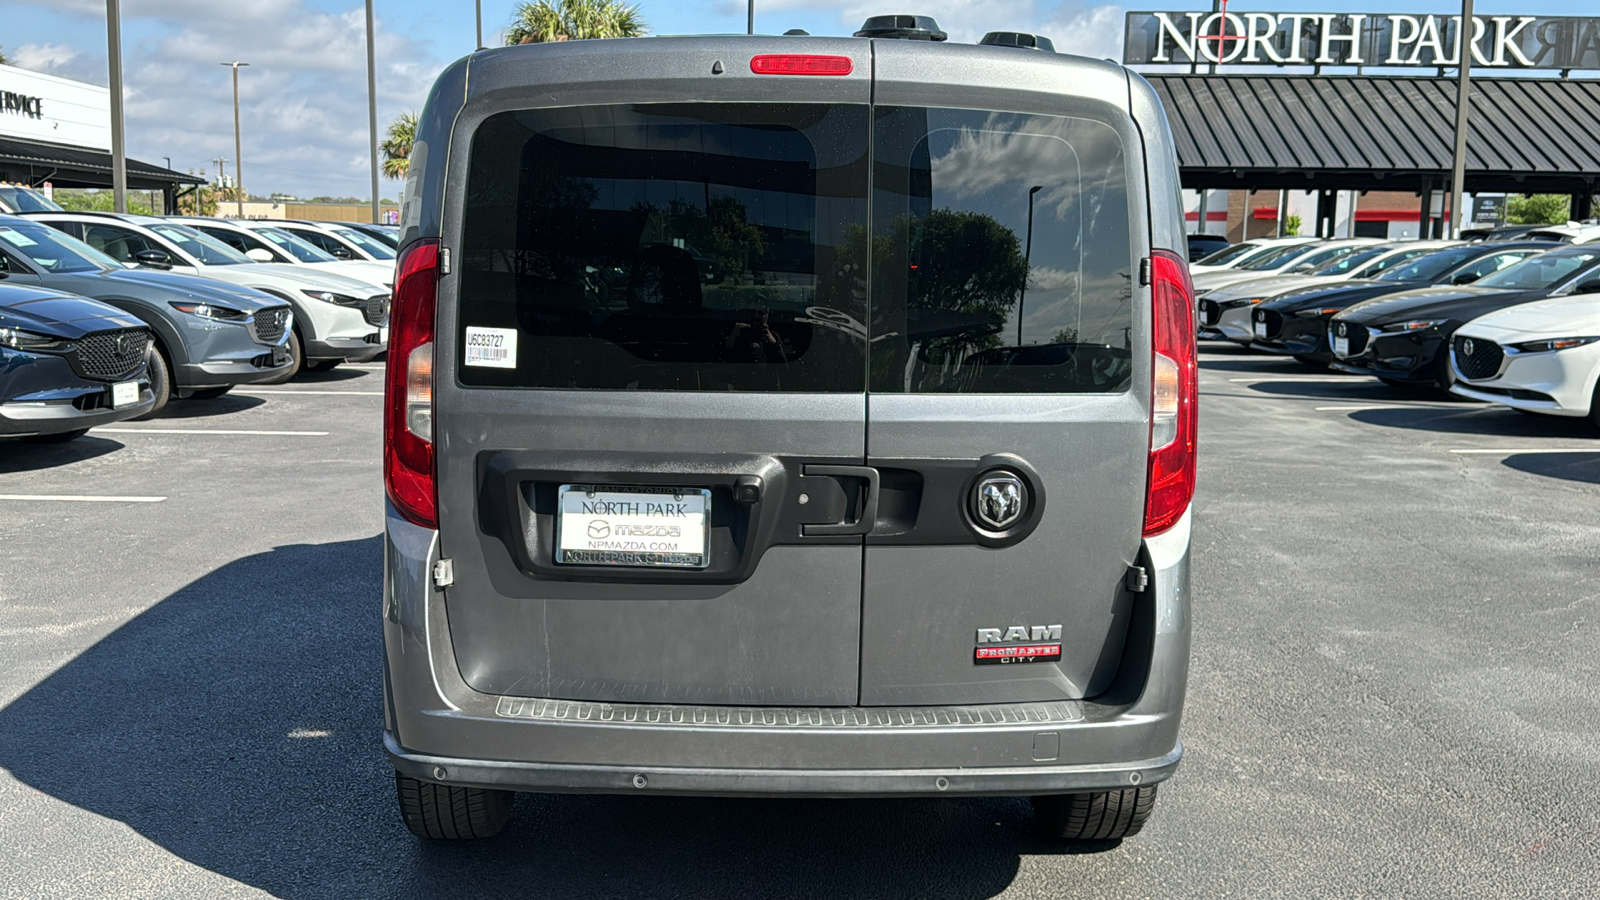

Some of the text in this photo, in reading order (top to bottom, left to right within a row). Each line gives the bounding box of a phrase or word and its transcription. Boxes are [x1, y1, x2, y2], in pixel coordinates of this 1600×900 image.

[1151, 12, 1367, 64] NORTH
[1386, 15, 1536, 66] PARK
[0, 90, 44, 118] ERVICE
[467, 333, 504, 348] U6C83727
[582, 500, 688, 518] NORTH PARK
[977, 624, 1062, 643] RAM
[1000, 656, 1036, 664] CITY
